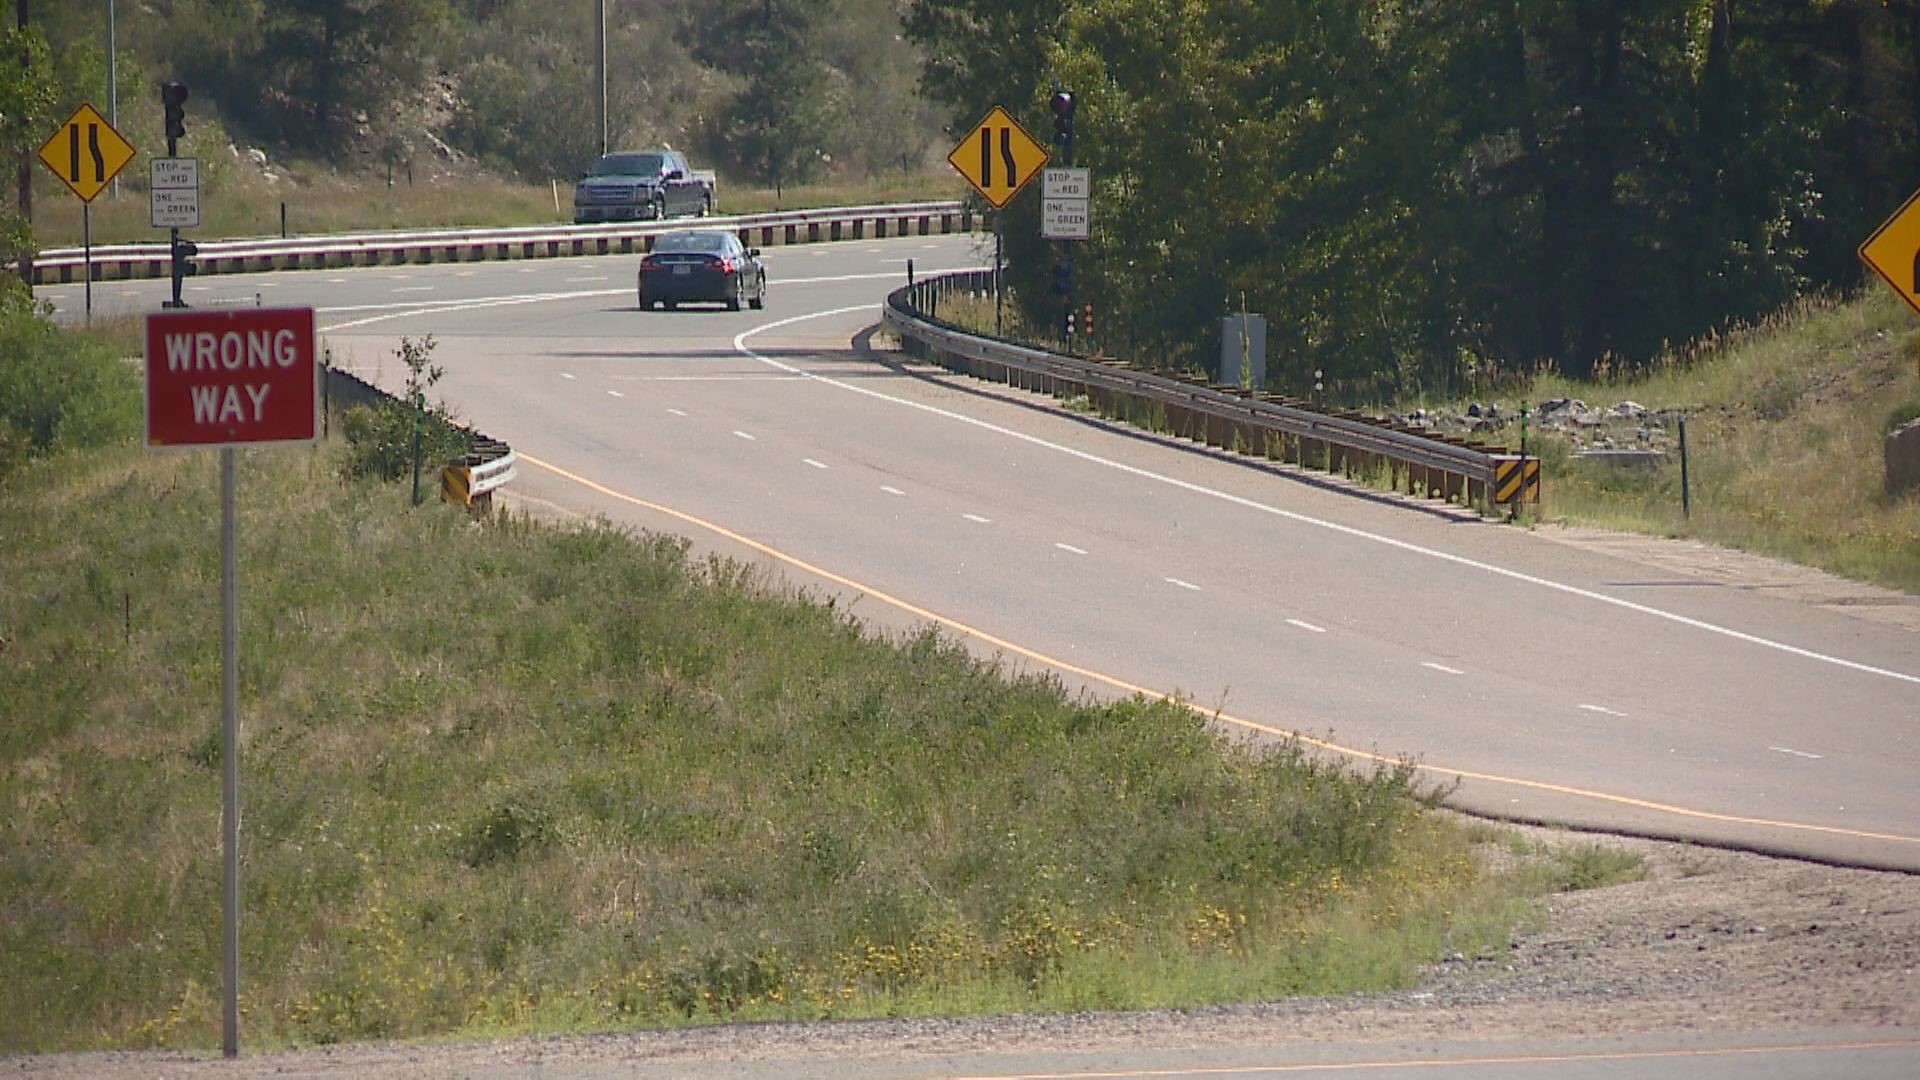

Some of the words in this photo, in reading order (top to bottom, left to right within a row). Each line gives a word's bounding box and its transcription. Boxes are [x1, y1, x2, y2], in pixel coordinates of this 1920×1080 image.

[155, 163, 178, 172] STOP
[1048, 173, 1070, 182] STOP
[1062, 185, 1079, 193] RED
[156, 193, 172, 202] ONE
[167, 205, 195, 213] GREEN
[1047, 203, 1063, 212] ONE
[1057, 215, 1085, 224] GREEN
[165, 329, 297, 371] WRONG
[191, 383, 270, 424] WAY
